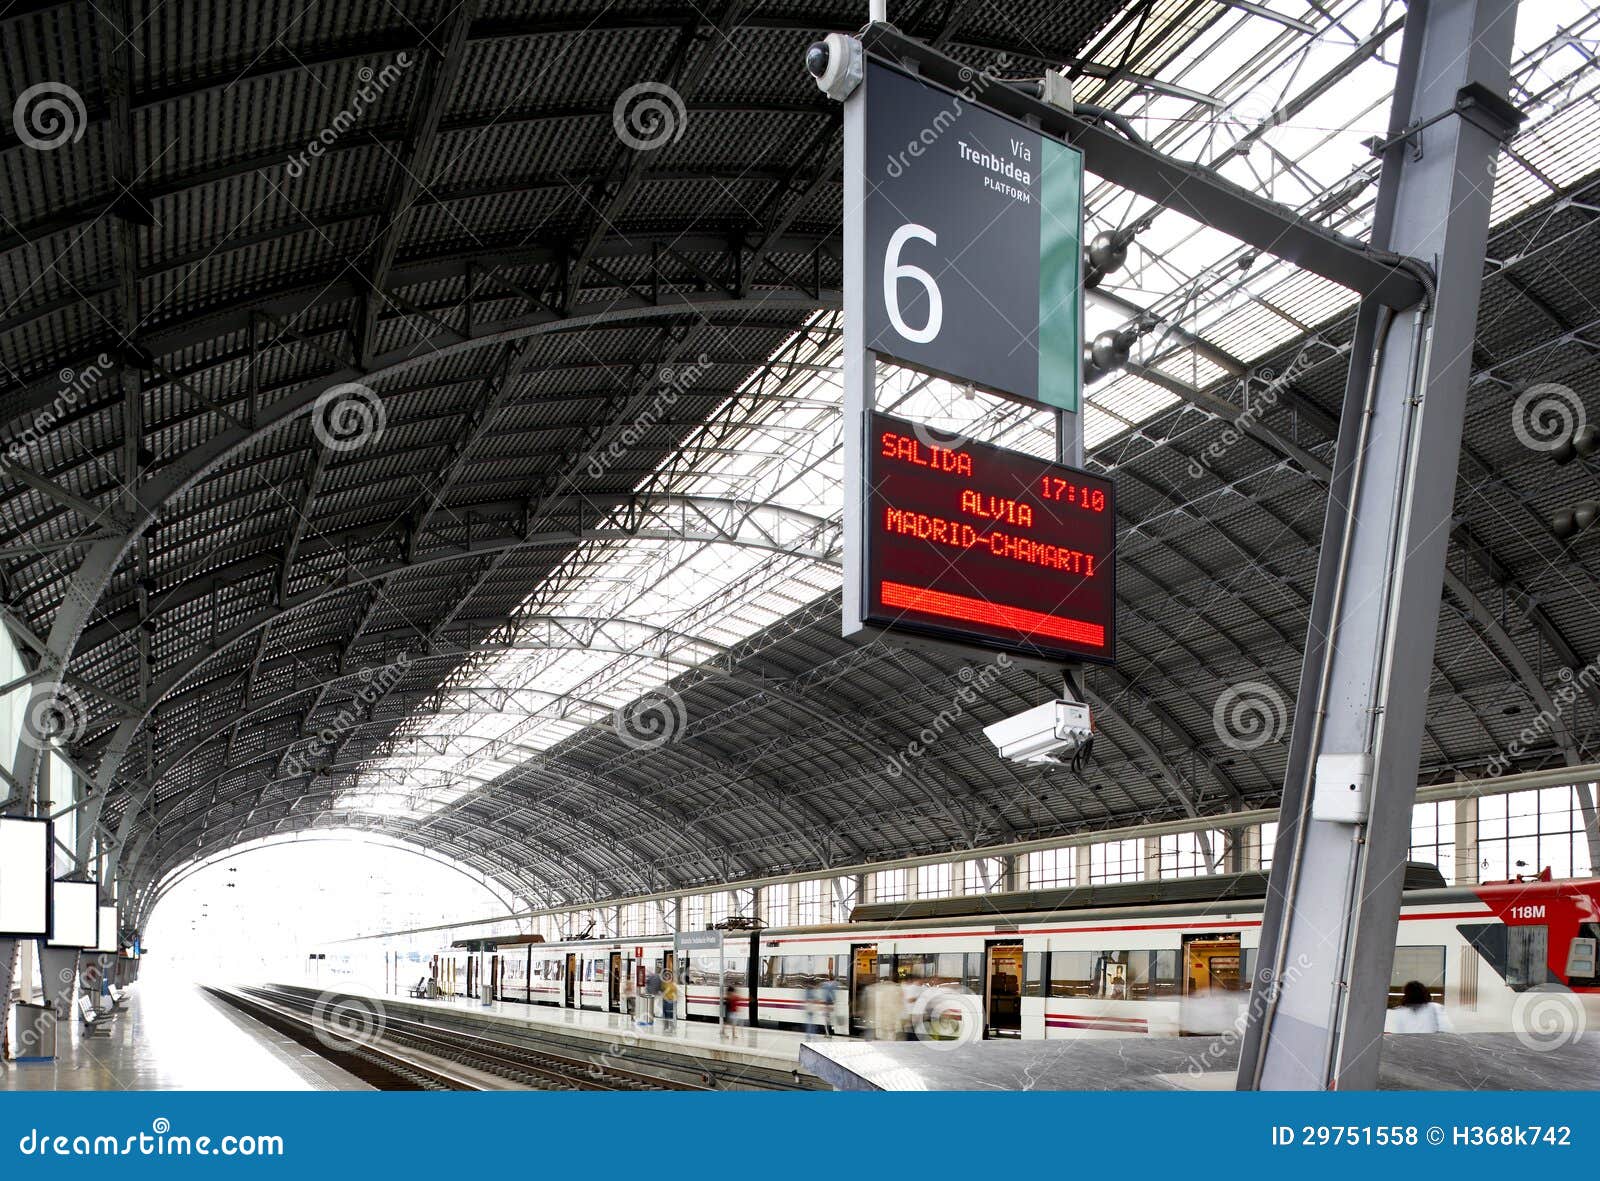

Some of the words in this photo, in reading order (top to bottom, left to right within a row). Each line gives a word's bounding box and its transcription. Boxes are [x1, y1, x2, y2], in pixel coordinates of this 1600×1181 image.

[958, 141, 1031, 185] Trenbidea
[1010, 138, 1031, 162] Vía
[984, 176, 1031, 204] PLATFORM
[883, 223, 943, 344] 6
[881, 432, 973, 477] SALIDA
[1041, 476, 1105, 513] 17:10
[962, 489, 1033, 528] ALVIA
[886, 507, 1095, 577] MADRID-CHAMARTI
[1510, 905, 1546, 919] 118M
